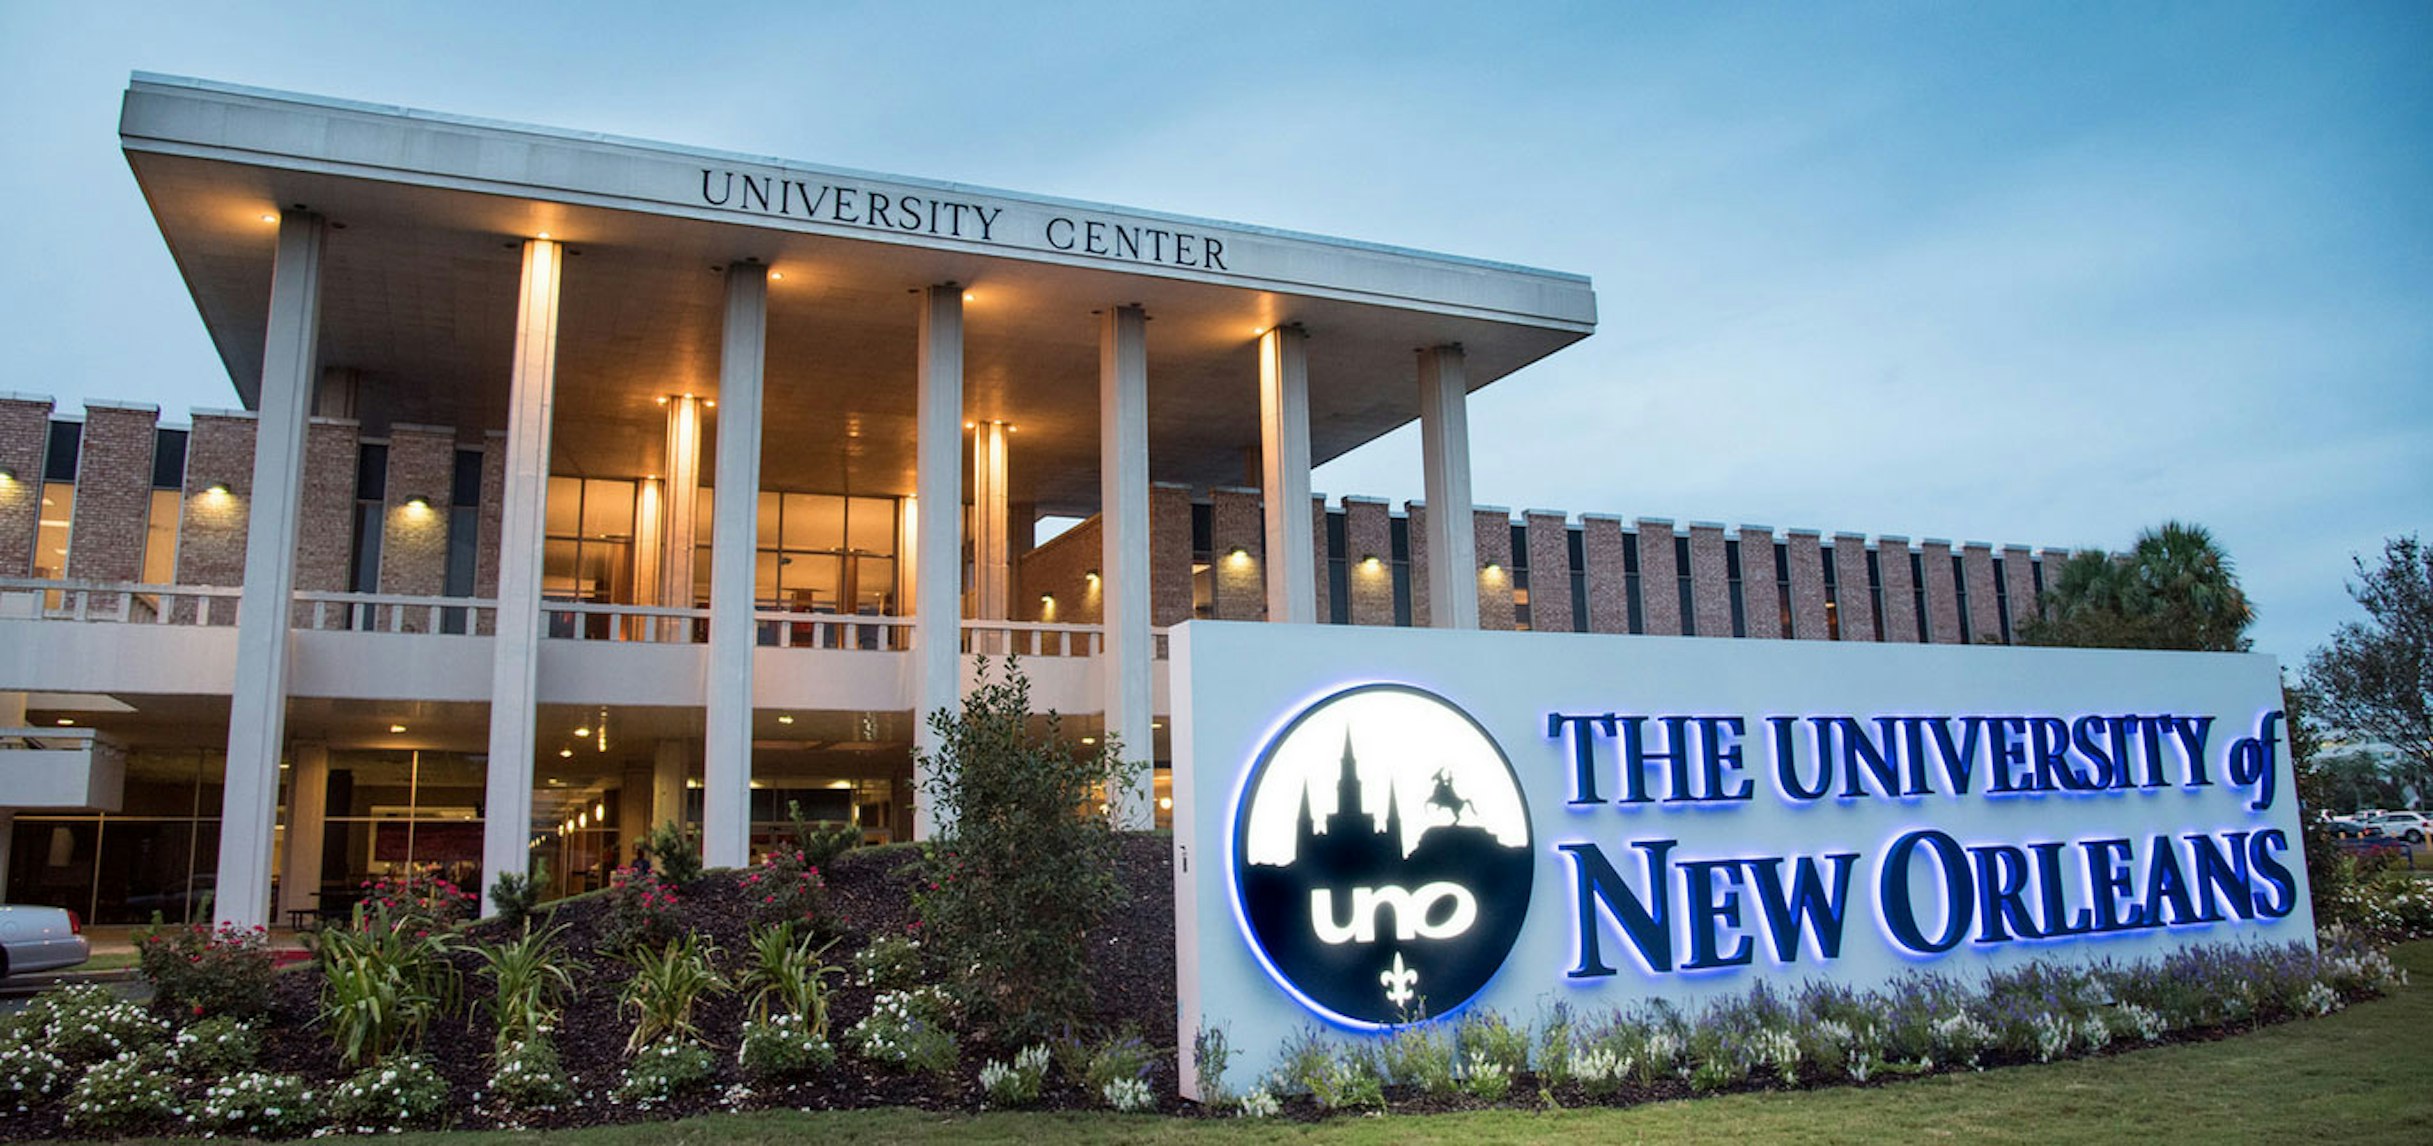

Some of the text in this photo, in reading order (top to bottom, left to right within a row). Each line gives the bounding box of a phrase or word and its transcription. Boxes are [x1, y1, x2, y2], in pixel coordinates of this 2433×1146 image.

[702, 169, 1228, 271] UNIVERSITY CENTER
[1547, 710, 2285, 811] THE UNIVERSITY of
[1311, 881, 1478, 945] uno
[1558, 828, 2297, 978] NEW ORLEANS
